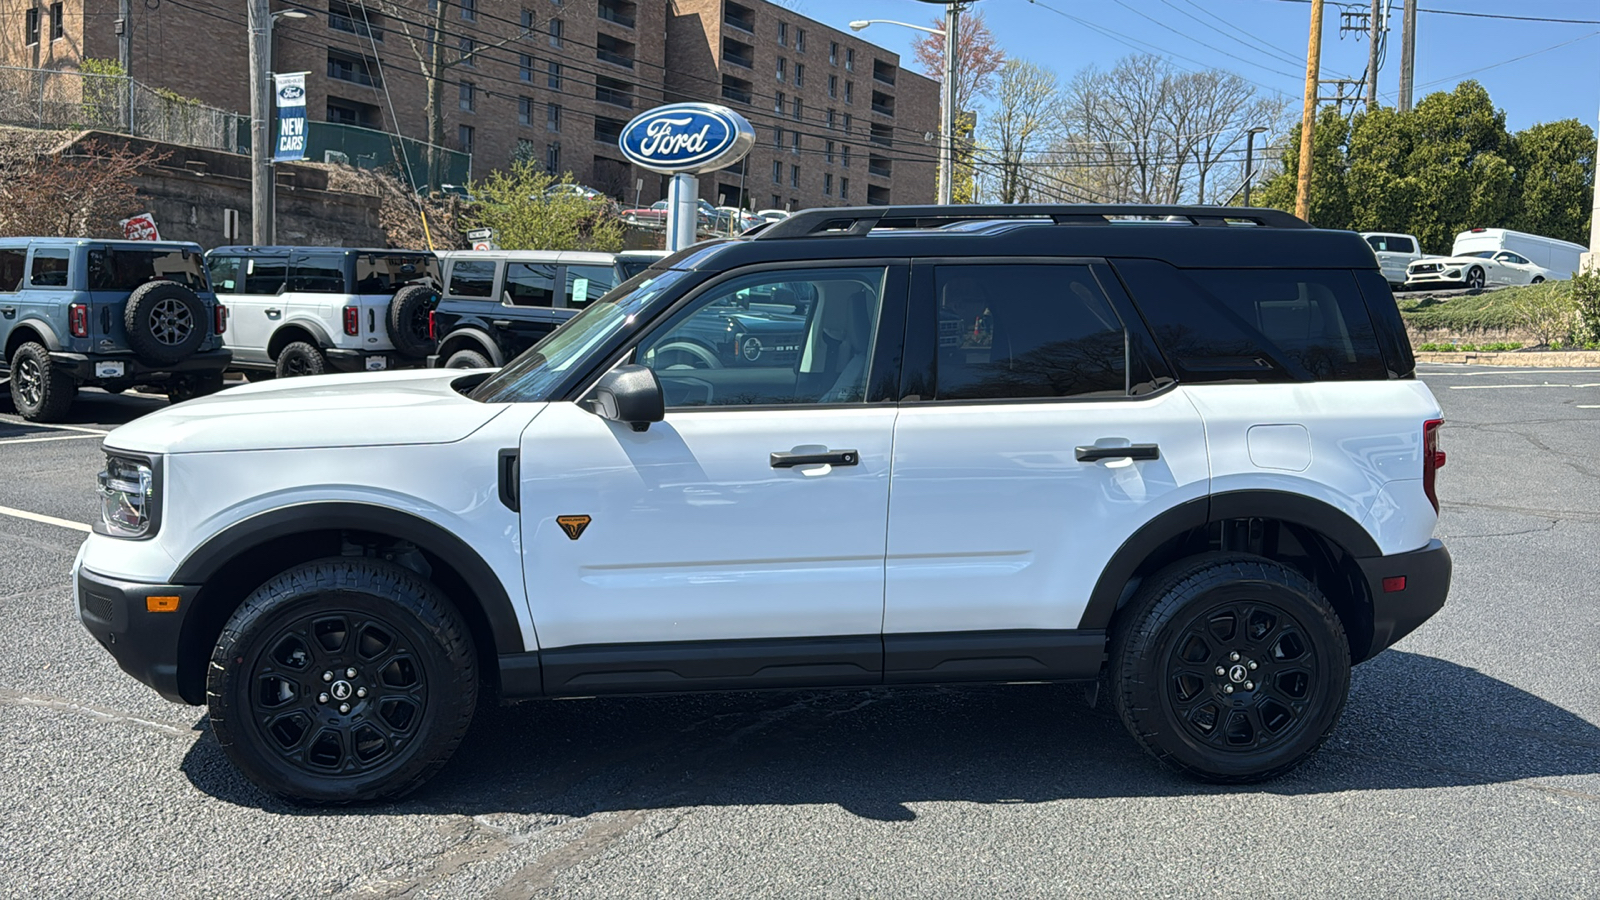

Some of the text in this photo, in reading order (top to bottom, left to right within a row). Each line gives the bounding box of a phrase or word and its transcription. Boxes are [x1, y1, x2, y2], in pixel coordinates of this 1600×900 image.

[283, 87, 301, 98] Ford
[281, 117, 304, 136] NEW
[280, 136, 304, 151] CARS
[640, 117, 710, 156] Ford
